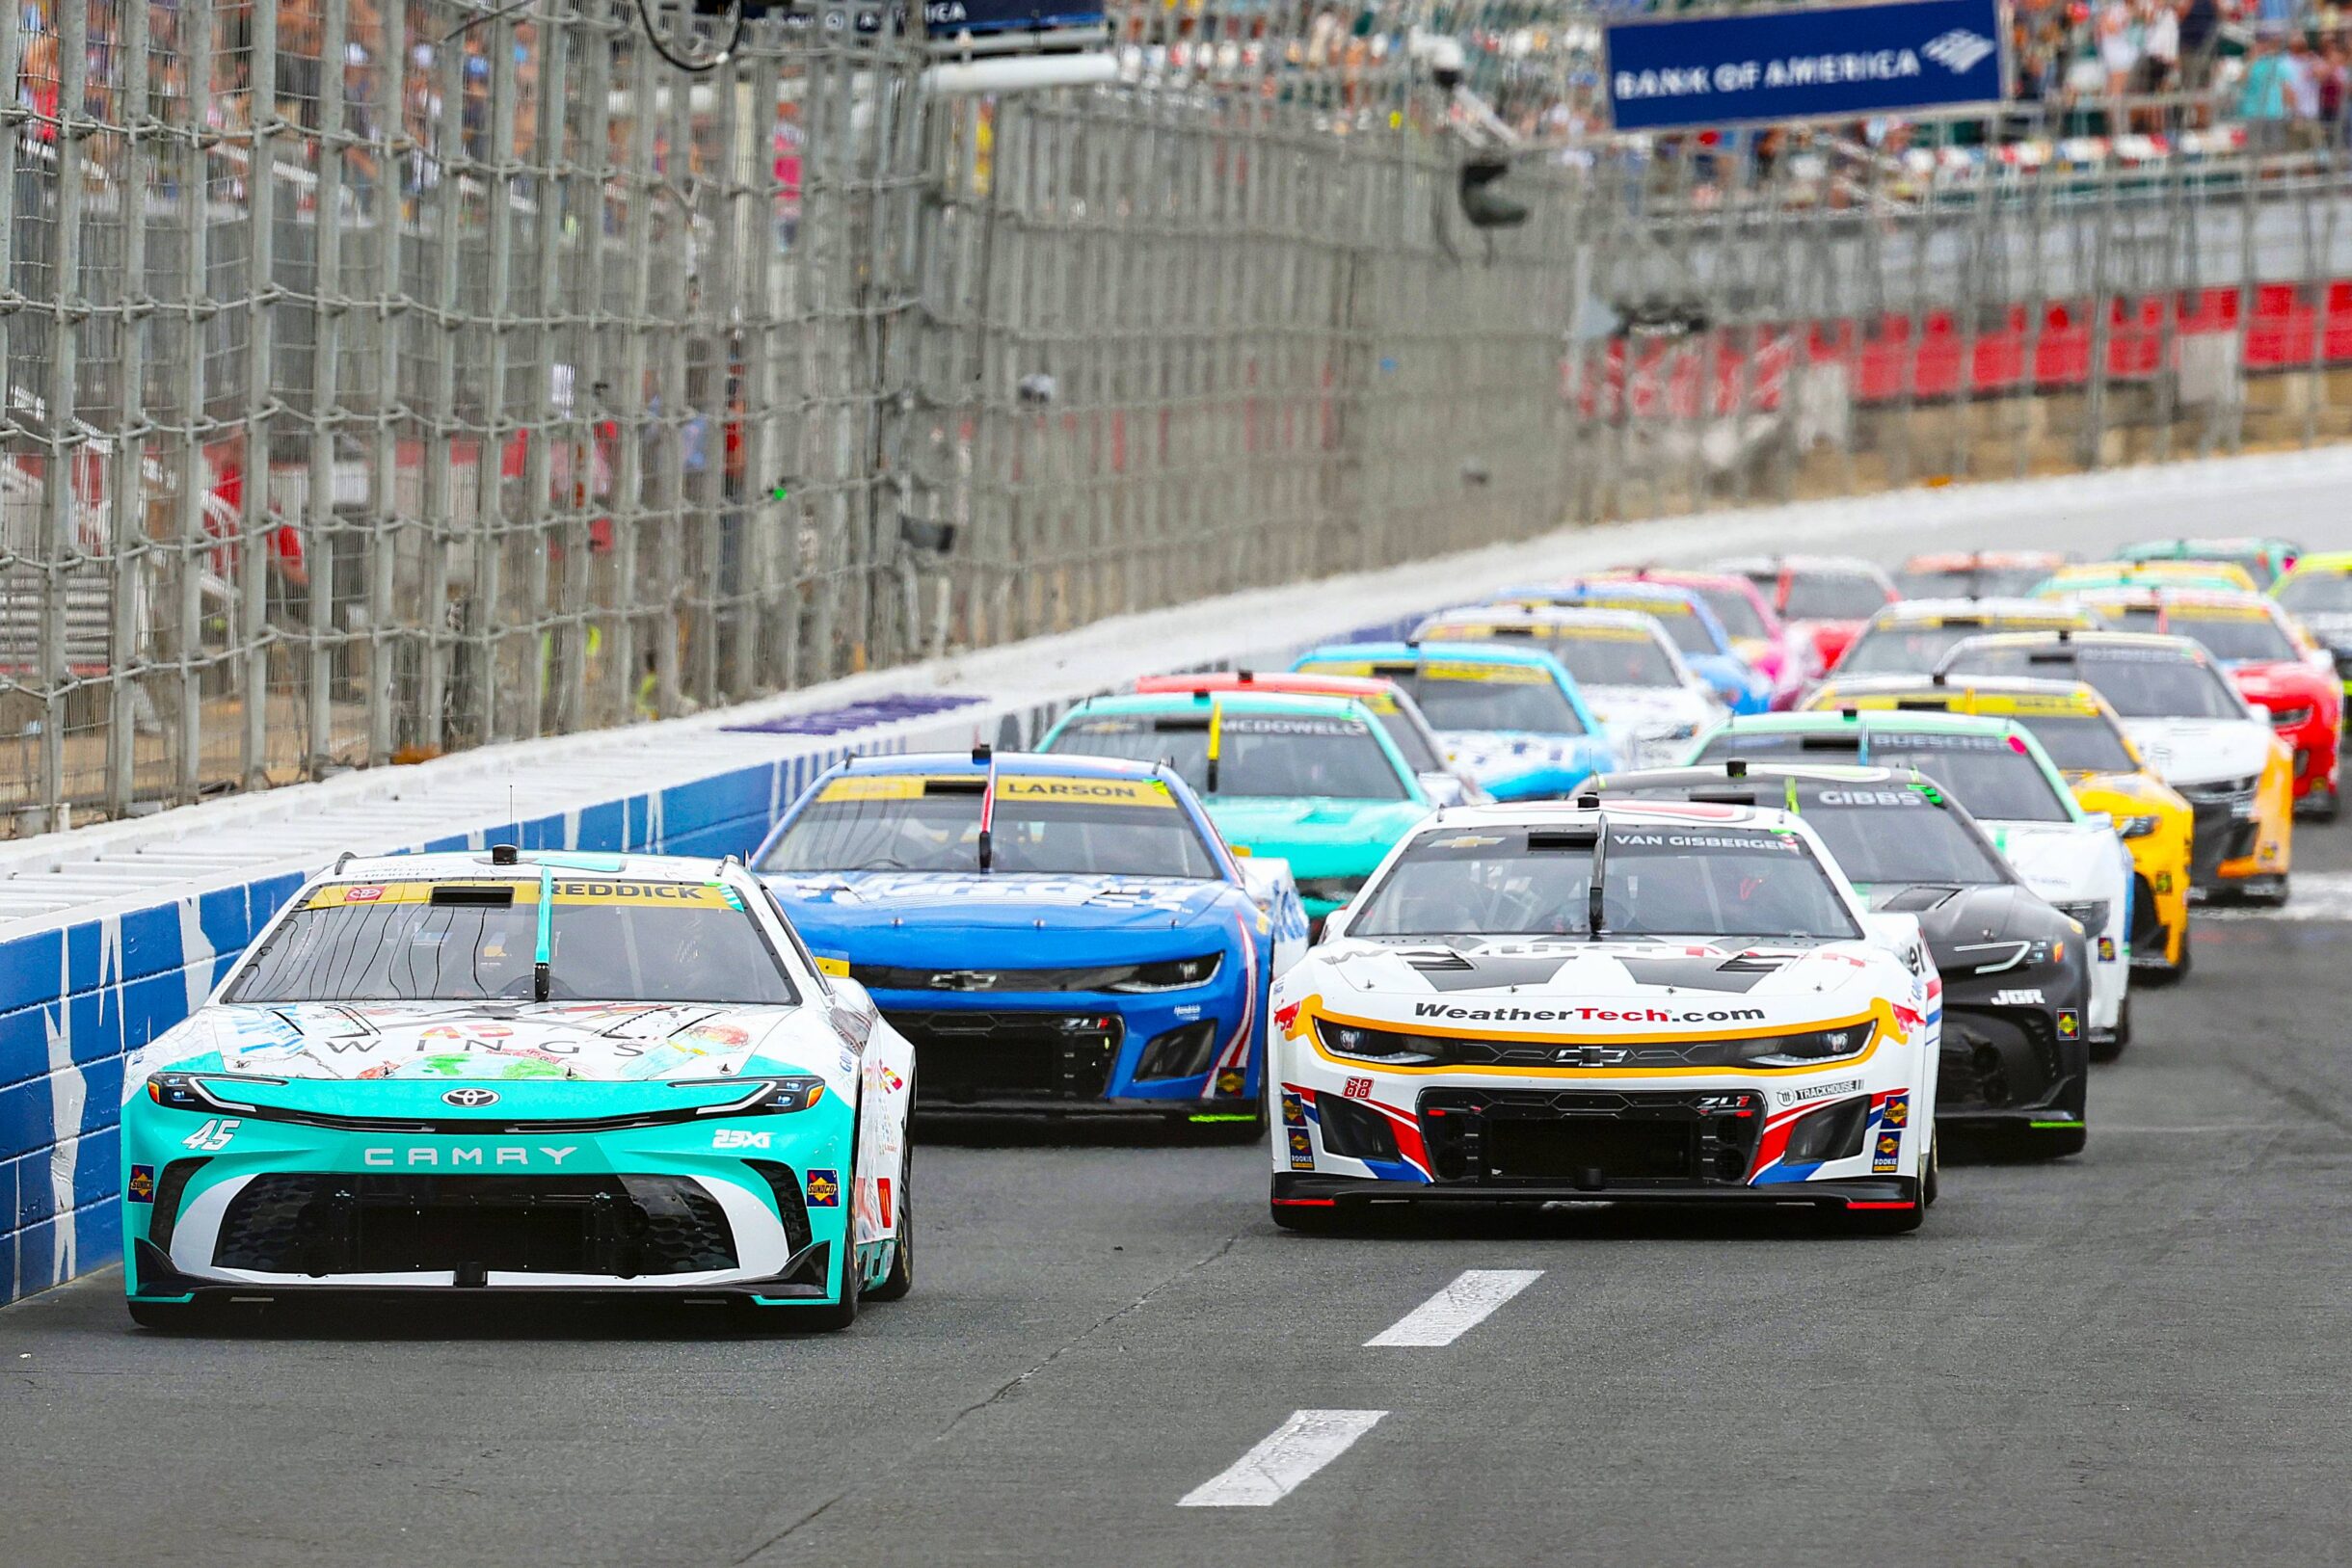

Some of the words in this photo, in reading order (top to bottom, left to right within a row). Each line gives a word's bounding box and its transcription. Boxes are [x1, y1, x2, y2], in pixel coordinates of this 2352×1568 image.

[1615, 66, 1711, 99] BANK
[1713, 61, 1762, 93] OF
[1764, 47, 1922, 89] AMERICA
[1008, 783, 1136, 798] LARSON
[1818, 790, 1922, 806] GIBBS
[1614, 835, 1664, 846] VAN
[538, 883, 704, 900] REDDICK
[1990, 989, 2045, 1005] JGR
[1415, 1002, 1766, 1023] WeatherTech.com
[324, 1039, 645, 1058] WINGS
[1342, 1076, 1375, 1099] 88
[1799, 1080, 1858, 1100] TRACKHOUSE
[1697, 1095, 1751, 1108] ZL1
[181, 1119, 242, 1151] 45
[711, 1129, 778, 1149] 23XI
[364, 1147, 578, 1165] CAMRY
[808, 1183, 837, 1195] SUNOCO
